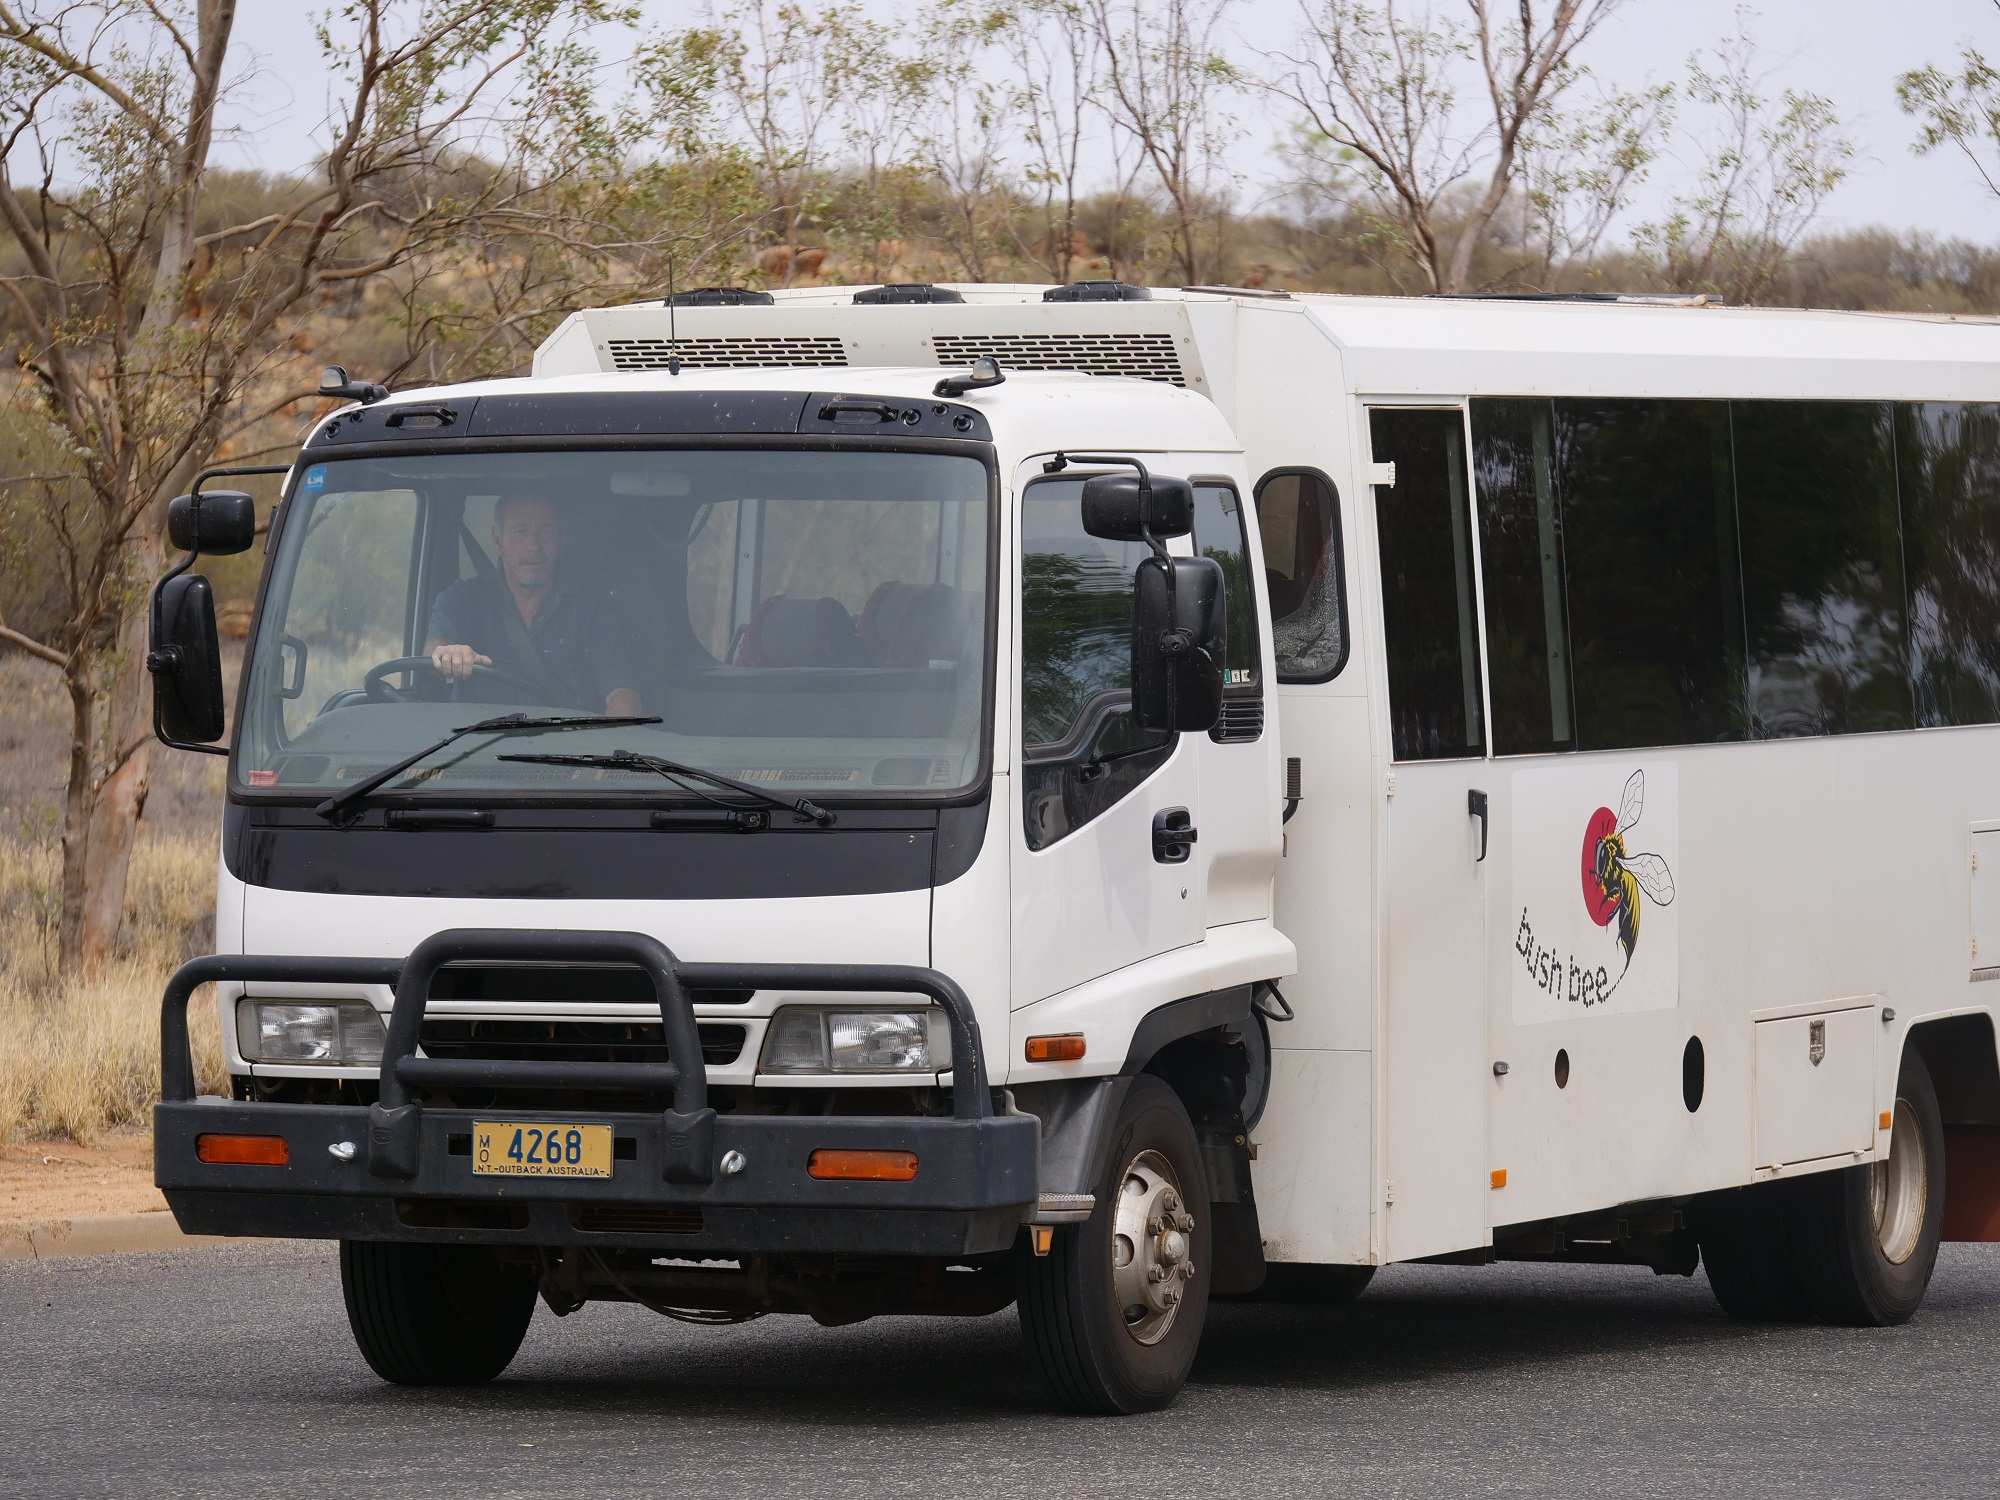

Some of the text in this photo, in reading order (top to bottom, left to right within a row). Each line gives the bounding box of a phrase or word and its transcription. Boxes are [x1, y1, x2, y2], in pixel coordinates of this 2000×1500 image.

[1515, 906, 1608, 1008] bush bee
[507, 1128, 582, 1165] 4268
